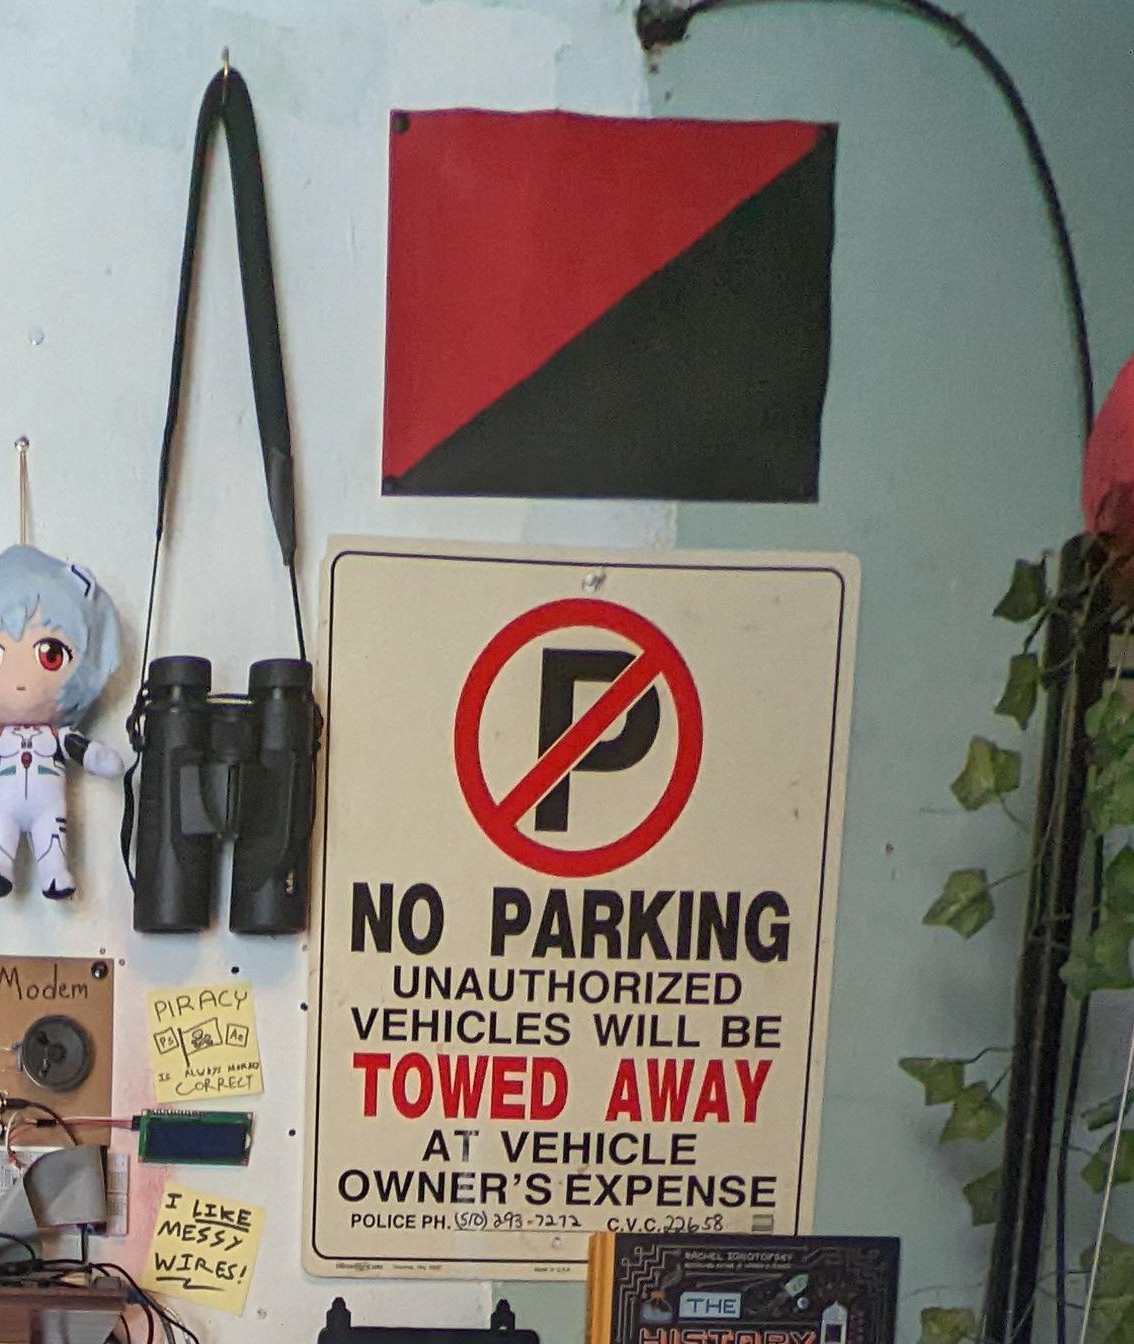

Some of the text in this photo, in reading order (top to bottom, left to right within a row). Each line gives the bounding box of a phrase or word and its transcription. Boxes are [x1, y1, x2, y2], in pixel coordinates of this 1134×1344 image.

[351, 882, 790, 963] NO PARKING
[393, 966, 742, 1005] UNAUTHORIZED
[154, 990, 247, 1022] PIRACY
[352, 1008, 782, 1049] VEHICLES WILL BE
[176, 1075, 253, 1096] CORRECT
[353, 1052, 773, 1123] TOWED AWAY
[422, 1130, 698, 1166] AT VEHICLE
[338, 1169, 778, 1207] OWNER'S EXPENSE
[165, 1193, 252, 1227] I LIKE
[351, 1214, 417, 1229] POLICE
[422, 1215, 451, 1230] PH.
[607, 1217, 662, 1233] C.V.C.
[157, 1220, 243, 1251] MESSY
[155, 1252, 247, 1285] WIRES!
[686, 1299, 736, 1315] THE
